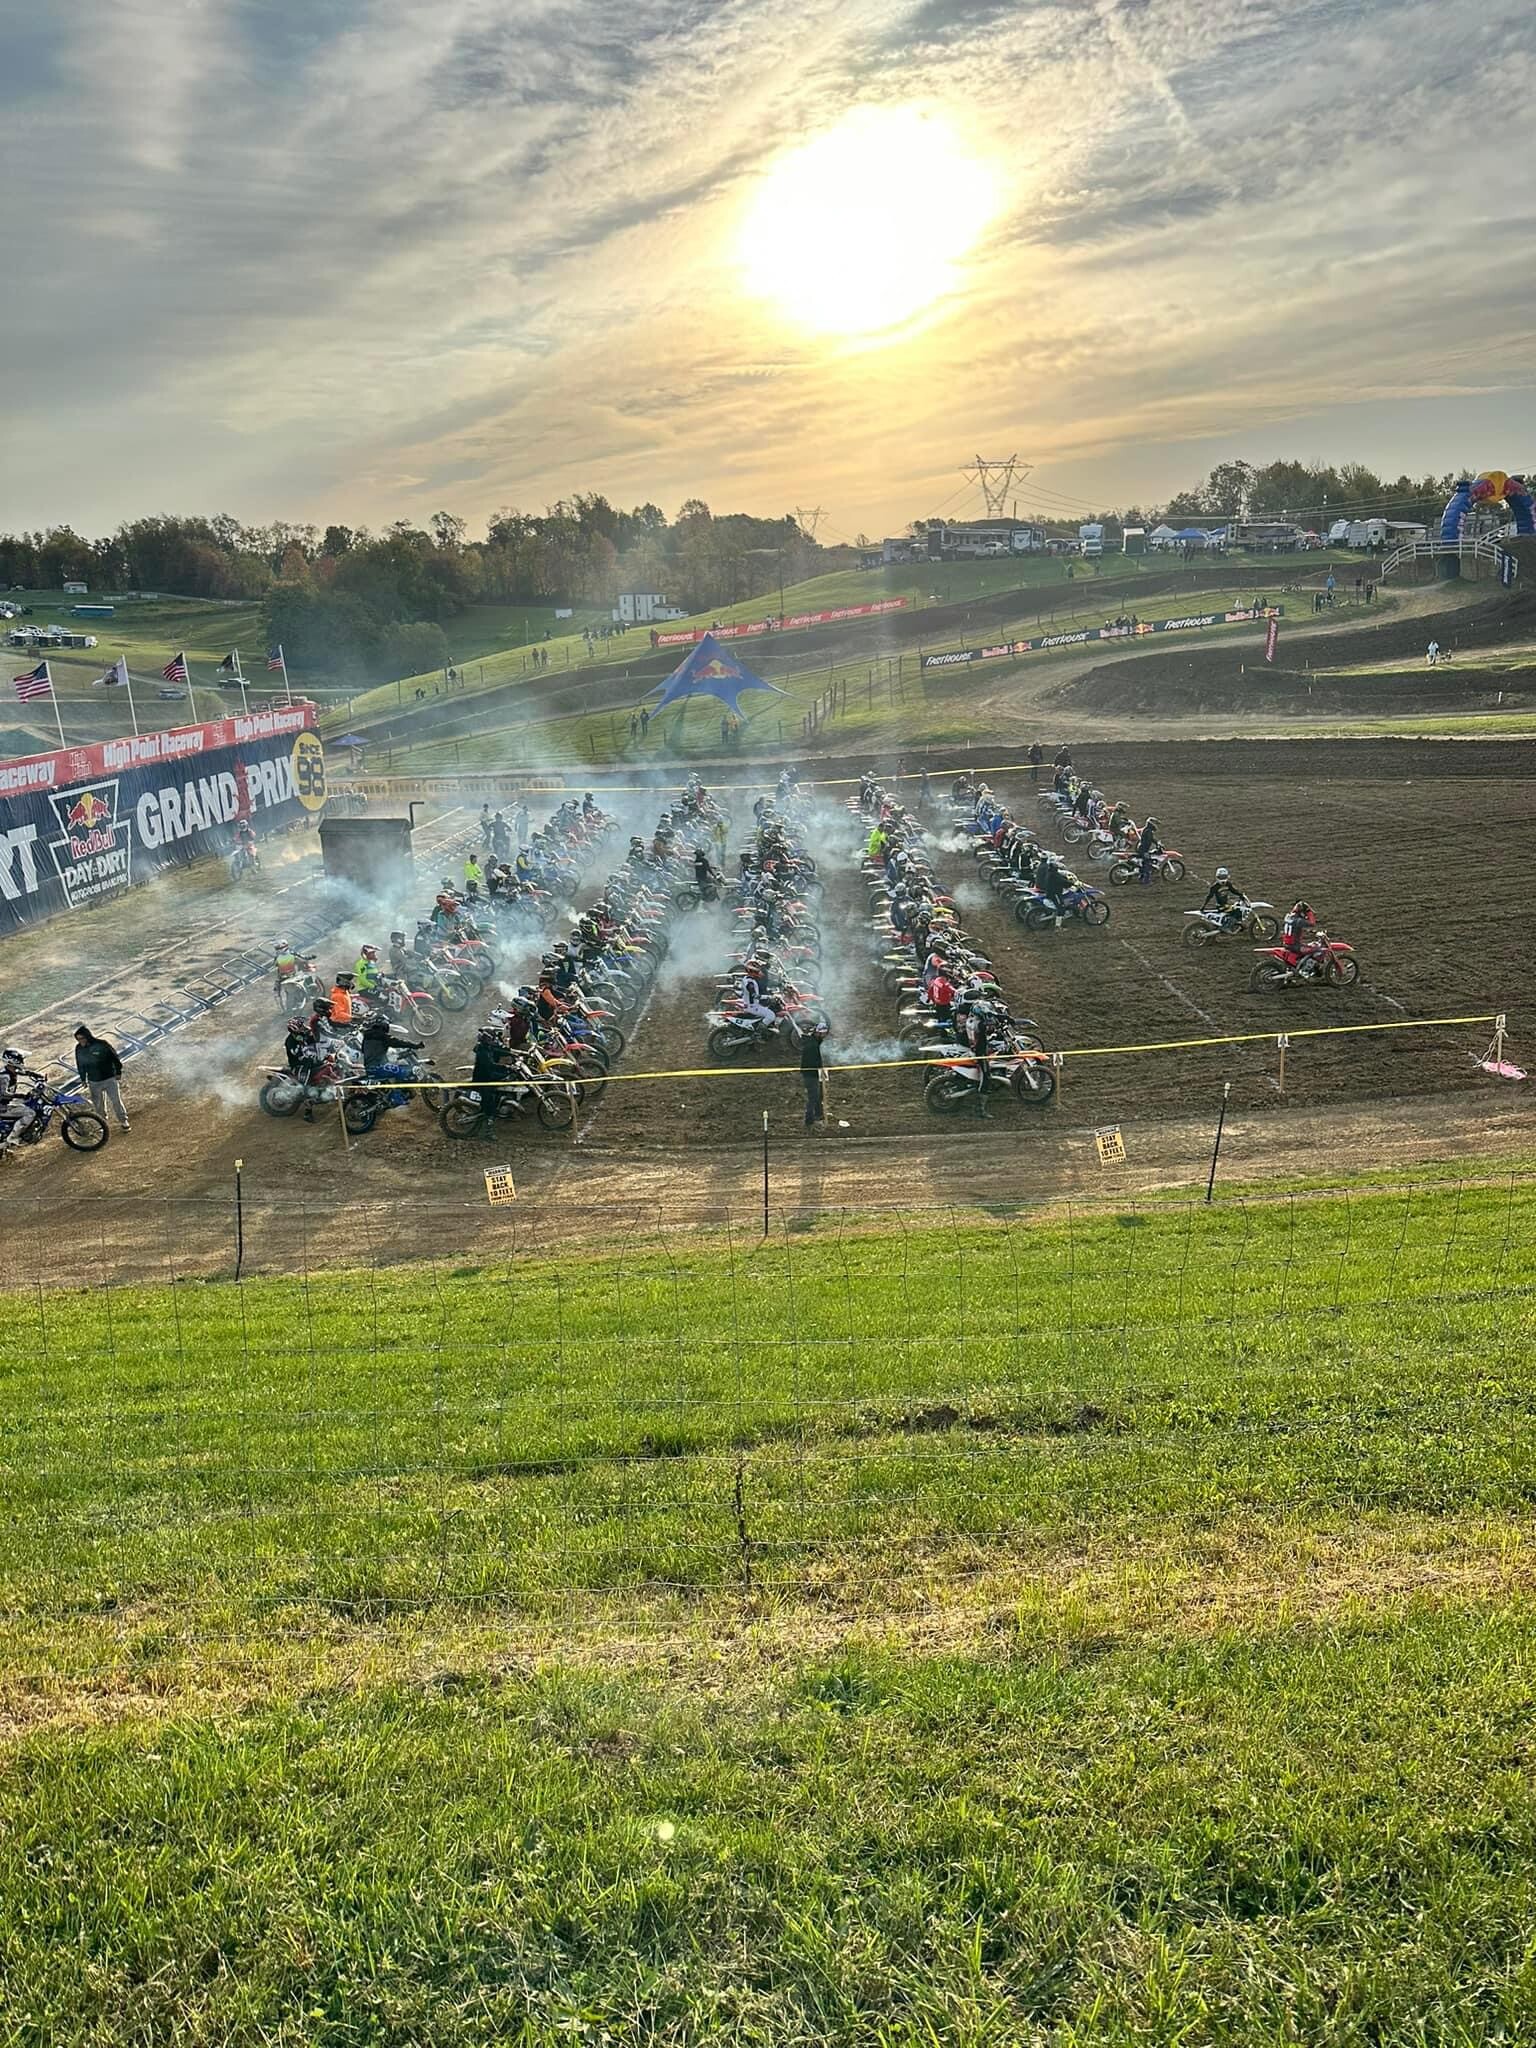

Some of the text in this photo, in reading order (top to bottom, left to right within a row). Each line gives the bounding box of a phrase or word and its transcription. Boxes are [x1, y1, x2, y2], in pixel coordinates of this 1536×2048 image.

[1041, 631, 1090, 647] FASTHOUSE
[926, 651, 973, 666] FASTHOUSE
[103, 741, 130, 769] High
[131, 735, 160, 761] Point
[160, 731, 204, 756] Raceway
[0, 760, 55, 790] aceway
[137, 755, 301, 849] GRAND PRIX
[65, 859, 93, 889] DAY
[96, 848, 126, 878] DIRT
